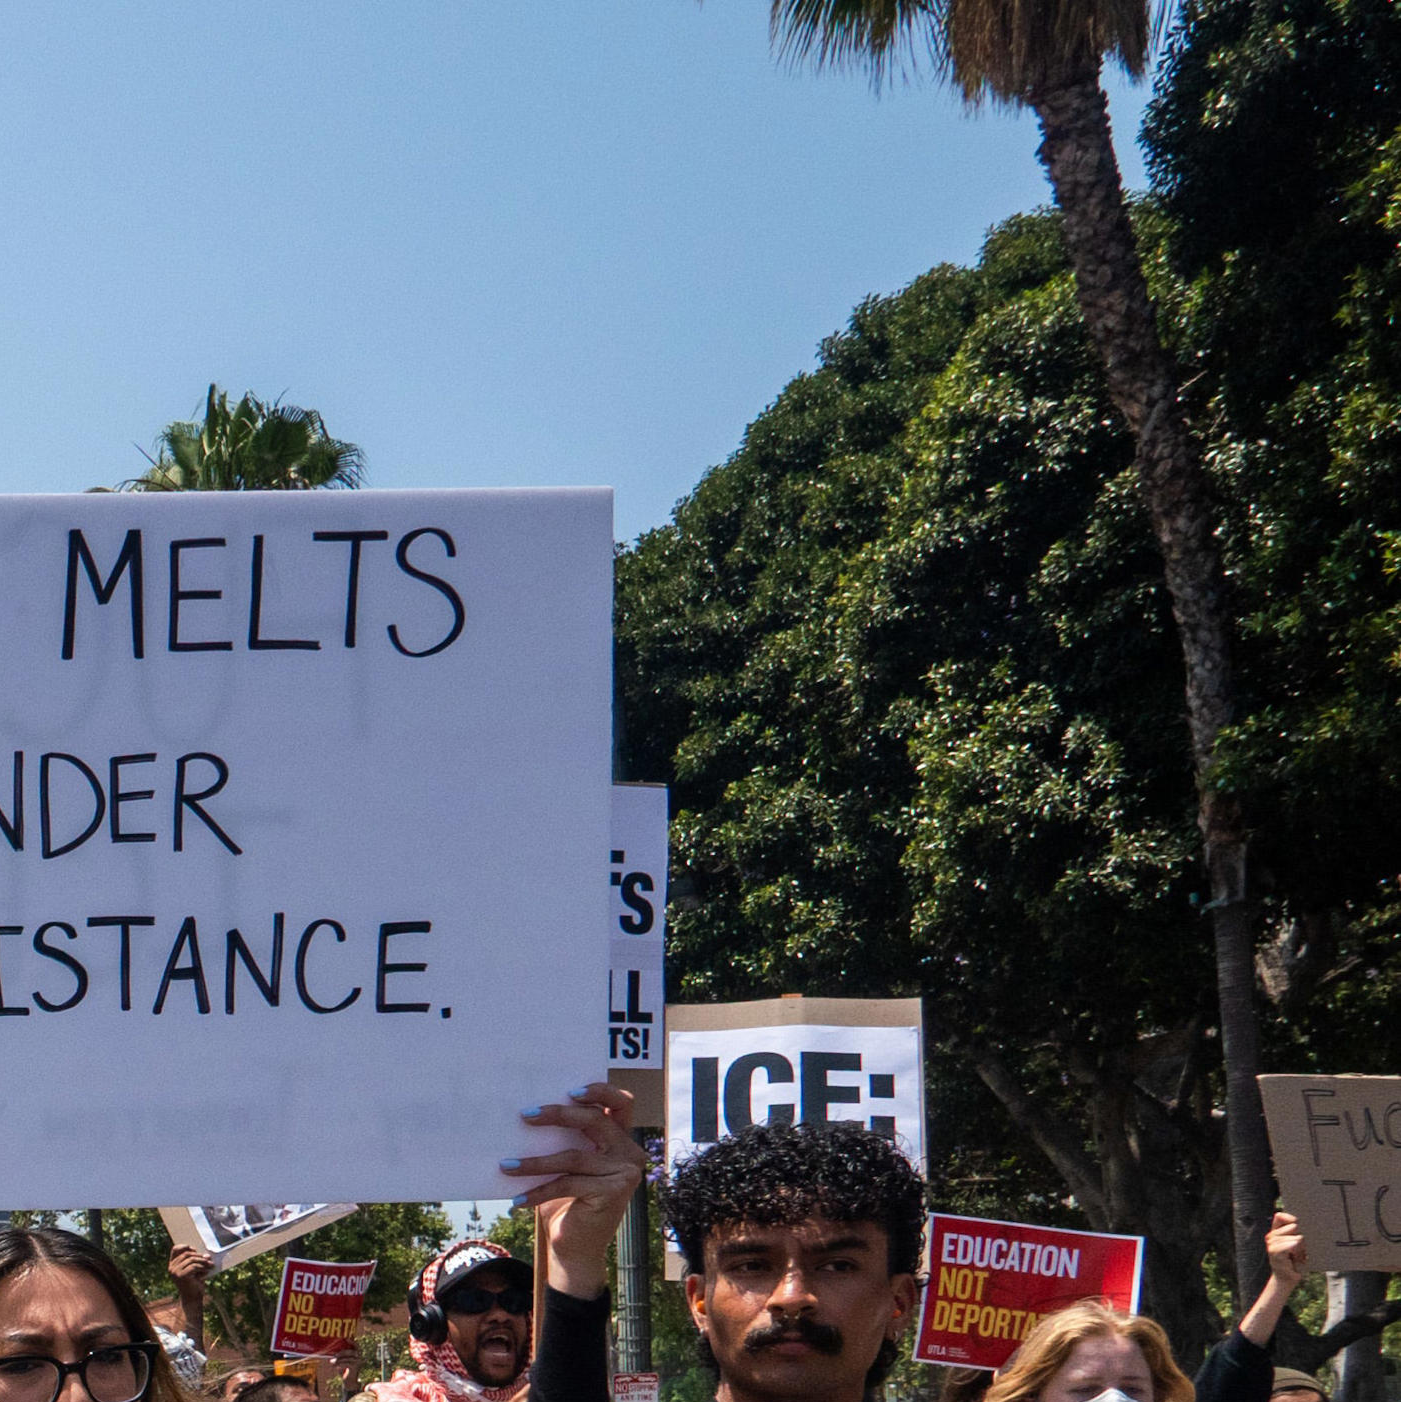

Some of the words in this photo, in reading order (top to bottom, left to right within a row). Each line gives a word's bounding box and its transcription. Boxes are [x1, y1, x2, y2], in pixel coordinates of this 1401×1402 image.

[61, 527, 466, 660] MELTS
[691, 1051, 896, 1146] ICE:
[940, 1232, 1080, 1279] EDUCATION
[287, 1292, 315, 1315] NO
[937, 1266, 990, 1302] NOT
